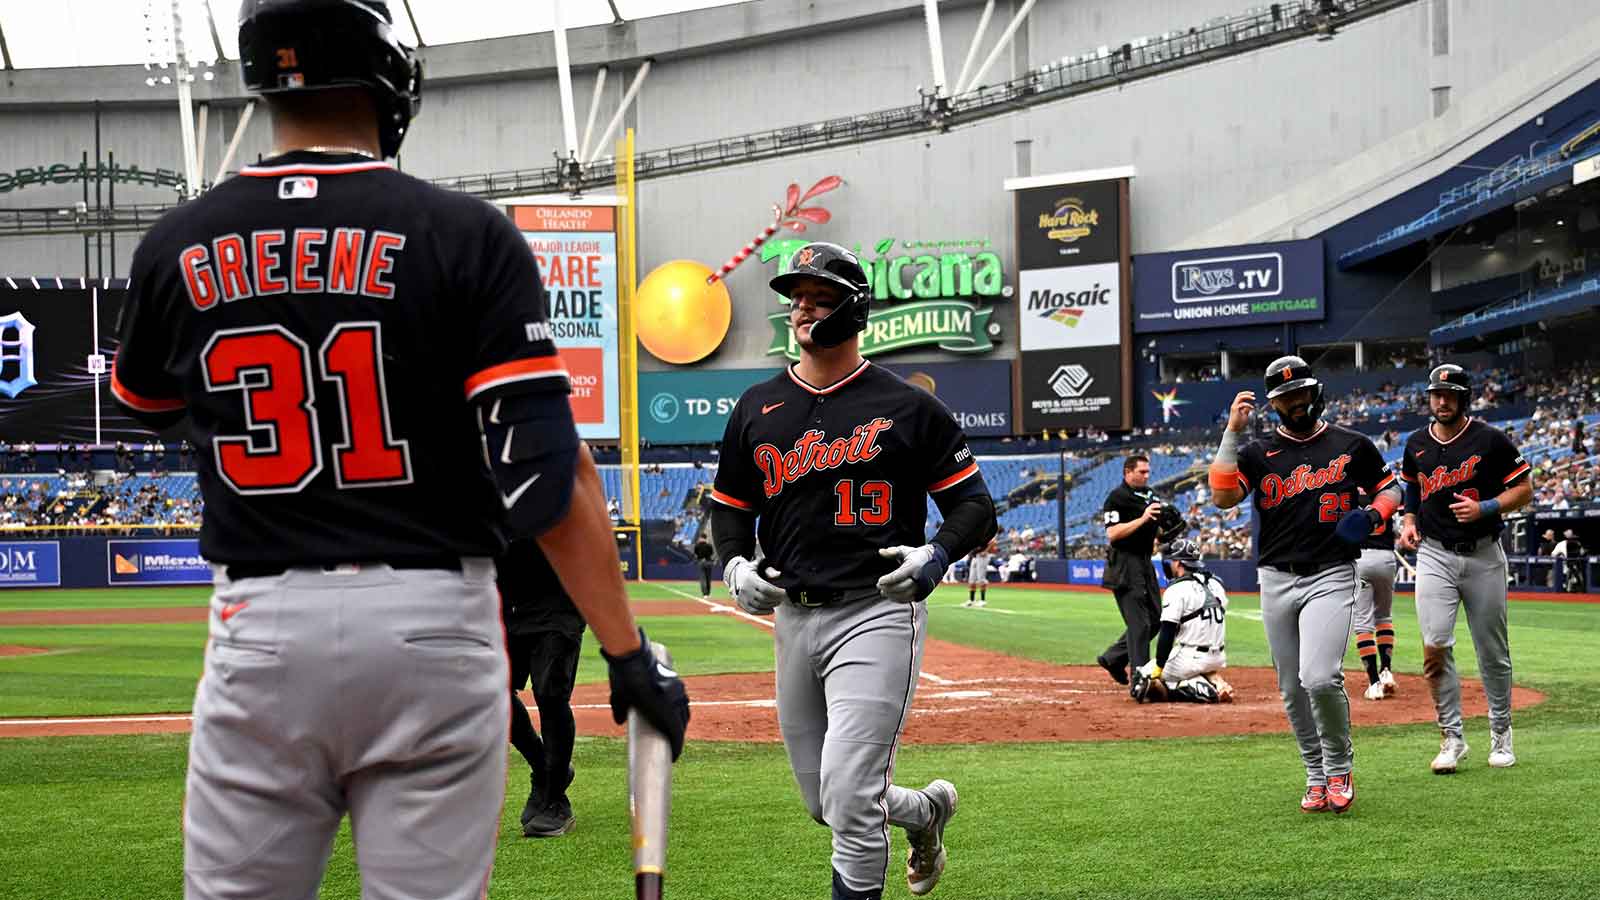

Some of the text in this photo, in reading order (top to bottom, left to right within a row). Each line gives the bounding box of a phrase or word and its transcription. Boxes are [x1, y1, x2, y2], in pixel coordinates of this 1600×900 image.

[536, 207, 592, 220] ORLANDO
[543, 219, 588, 230] HEALTH
[1069, 208, 1098, 226] Rock
[564, 240, 601, 253] LEAGUE
[179, 227, 406, 311] GREENE
[1026, 283, 1111, 310] Mosaic
[1174, 307, 1212, 320] UNION
[1214, 303, 1249, 316] HOME
[1251, 297, 1318, 313] MORTGAGE
[200, 321, 414, 495] 31
[685, 399, 711, 416] TD
[754, 417, 894, 499] Detroit
[1260, 454, 1352, 510] Detroit
[1418, 455, 1482, 500] Detroit
[834, 479, 893, 526] 13
